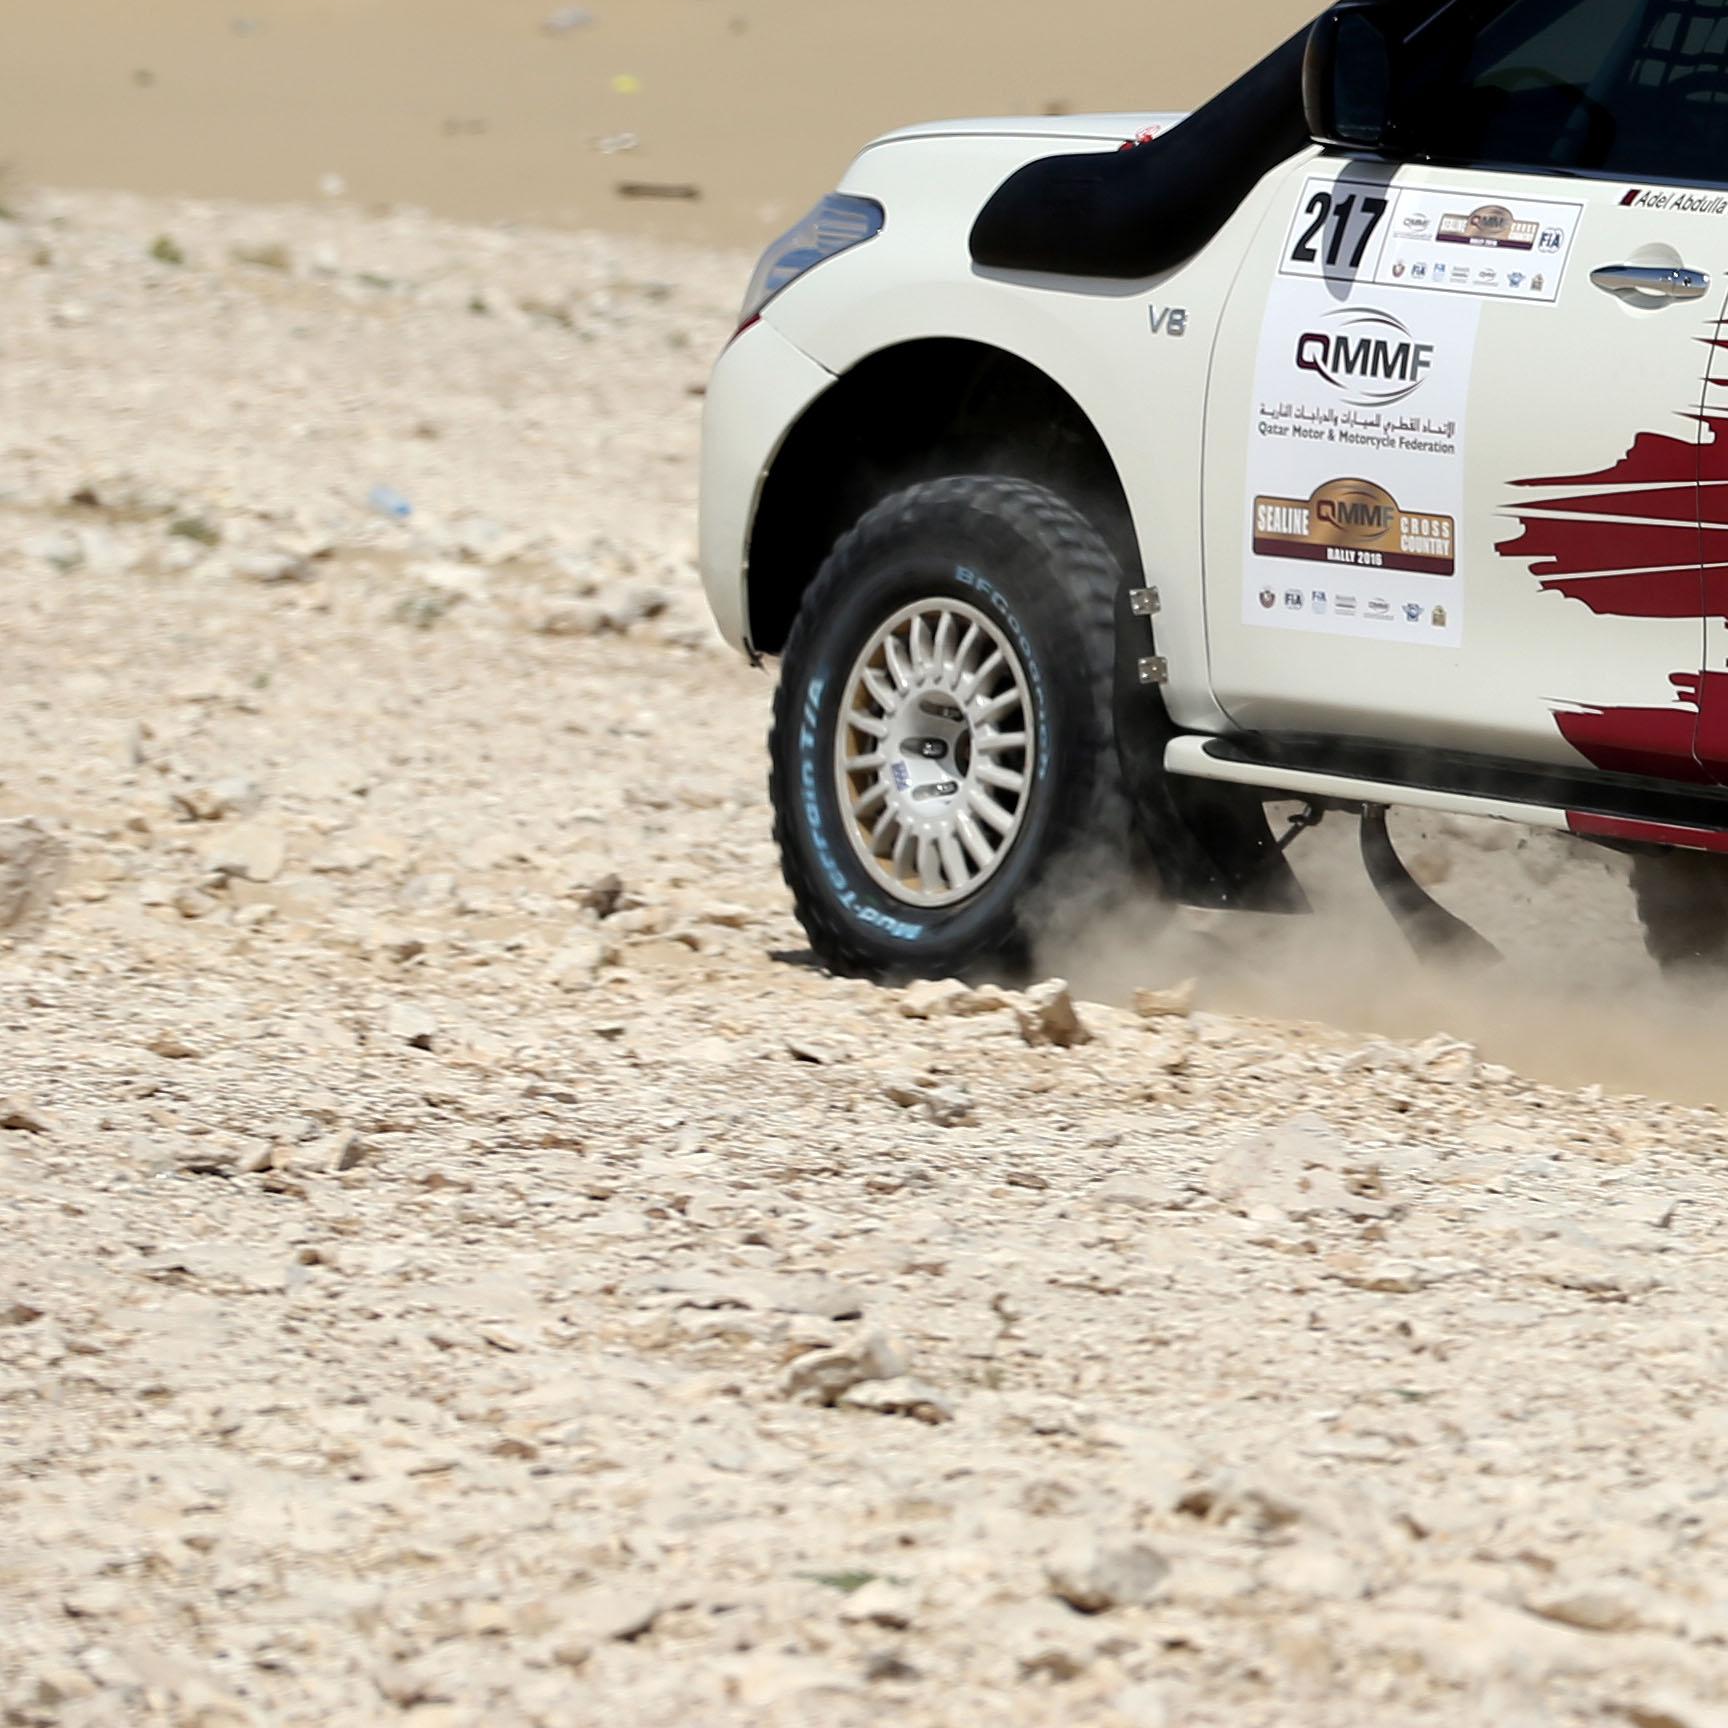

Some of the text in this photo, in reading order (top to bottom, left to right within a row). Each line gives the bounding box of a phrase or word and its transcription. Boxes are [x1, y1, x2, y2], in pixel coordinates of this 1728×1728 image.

[1635, 190, 1672, 209] Adel
[1670, 193, 1725, 215] Abdulla
[1291, 191, 1389, 268] 217
[1539, 231, 1561, 248] FIA
[1148, 304, 1189, 337] V8
[1296, 332, 1434, 386] QMMF
[1258, 421, 1455, 455] Qatar Motor & Motorcycle Federation
[1257, 504, 1310, 536] SEALINE
[1317, 499, 1394, 529] QMMF
[1401, 516, 1450, 538] CROSS
[1327, 547, 1383, 566] RALLY 2016
[1401, 536, 1449, 556] COUNTRY
